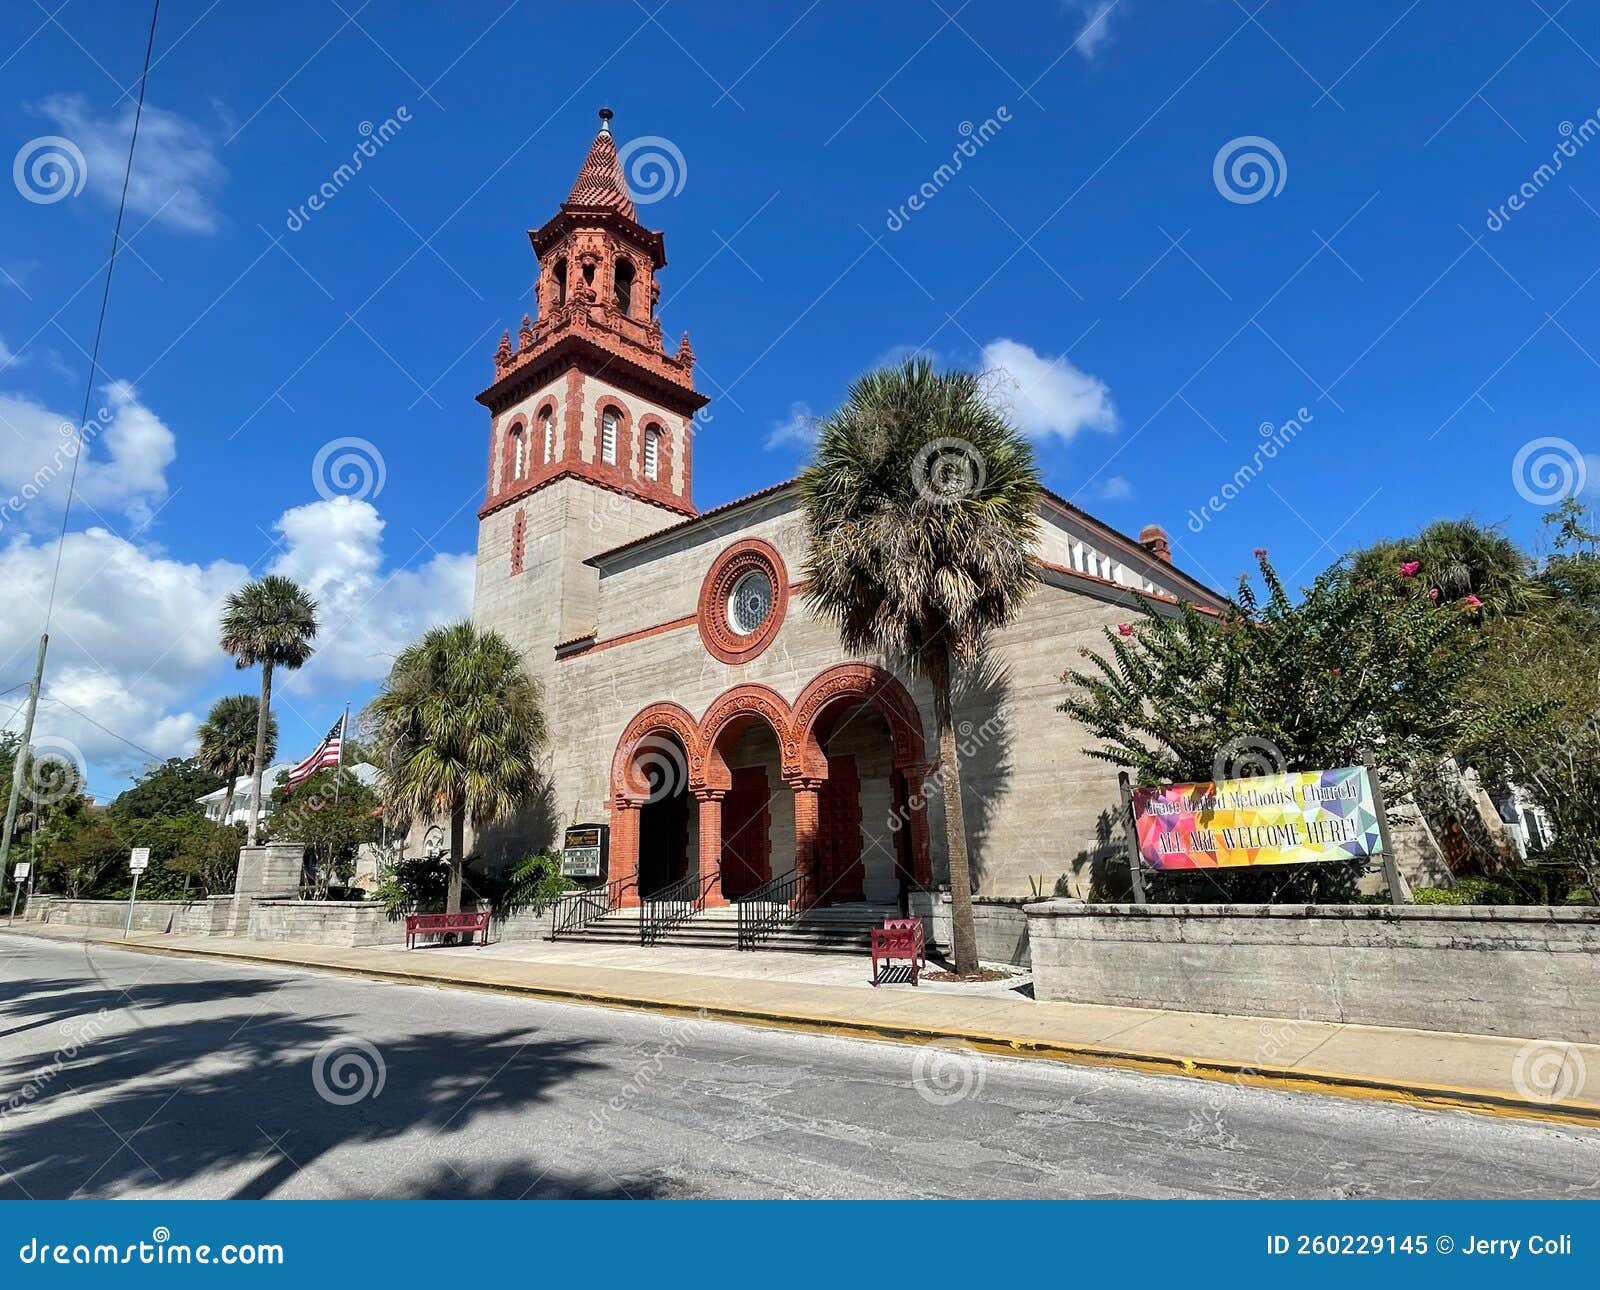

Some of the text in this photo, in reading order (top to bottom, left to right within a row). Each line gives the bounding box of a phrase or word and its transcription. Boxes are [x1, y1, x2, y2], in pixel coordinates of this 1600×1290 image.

[1230, 786, 1298, 809] Methodist
[1301, 779, 1358, 802] Church
[1158, 818, 1358, 854] ALL ARE WELCOME HERE!
